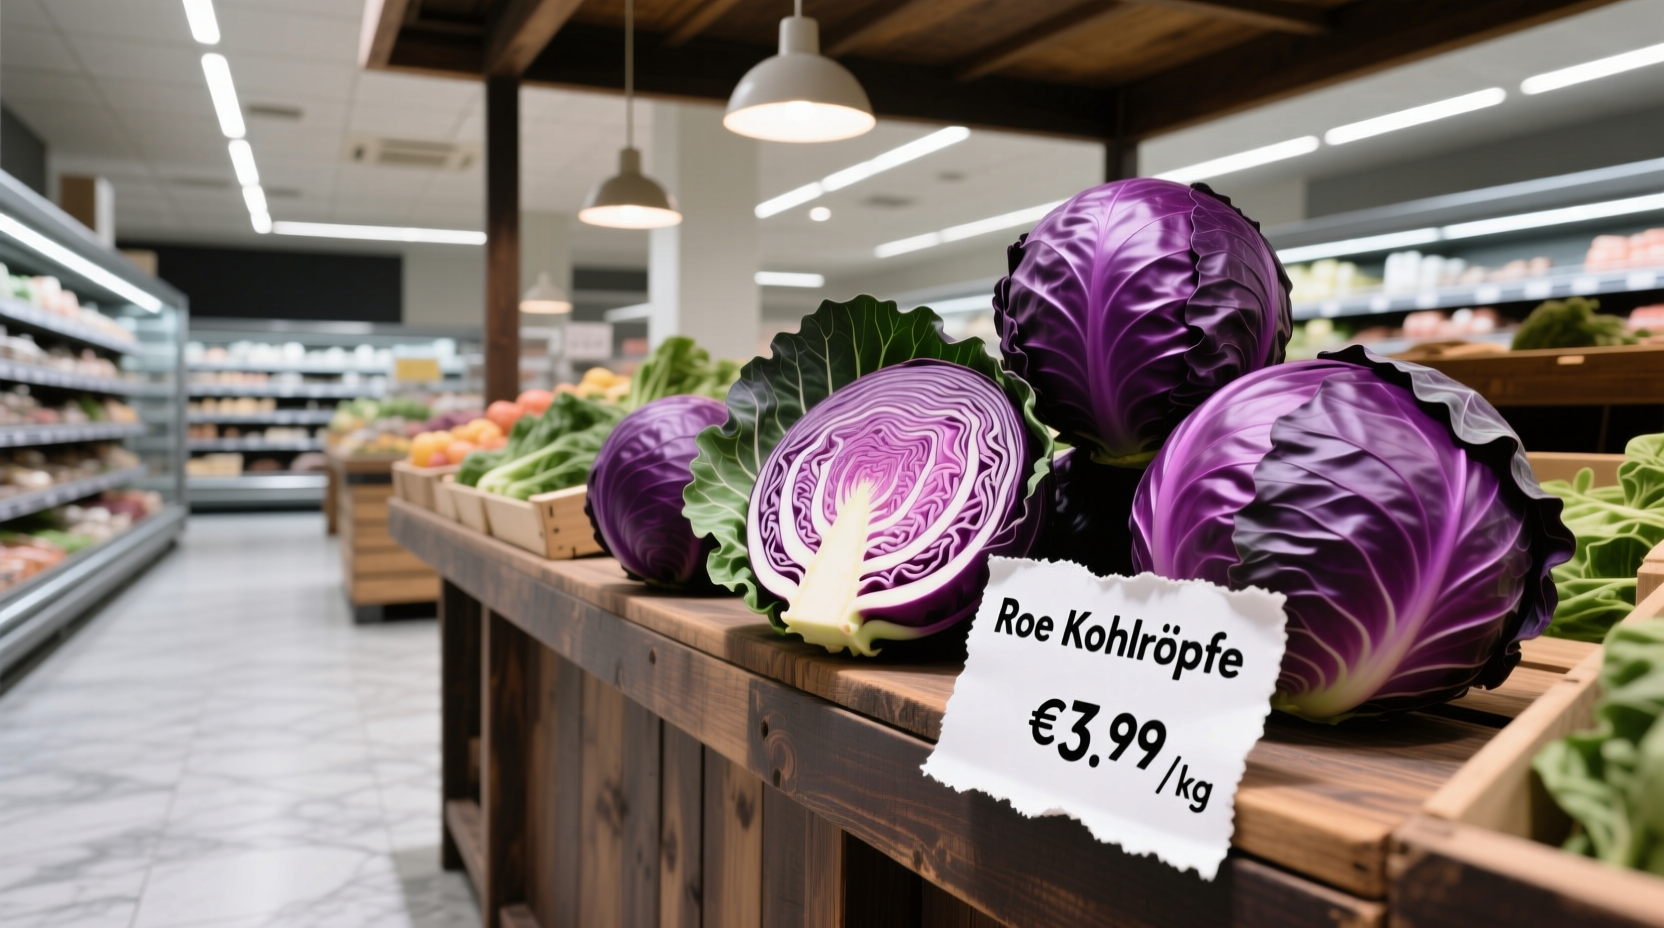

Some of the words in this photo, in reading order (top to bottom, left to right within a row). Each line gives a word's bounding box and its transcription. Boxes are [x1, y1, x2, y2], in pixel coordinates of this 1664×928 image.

[994, 597, 1054, 642] Roe
[1061, 609, 1244, 681] Kohlröpfe
[1028, 698, 1167, 771] €3.99
[1155, 755, 1214, 814] /kg
